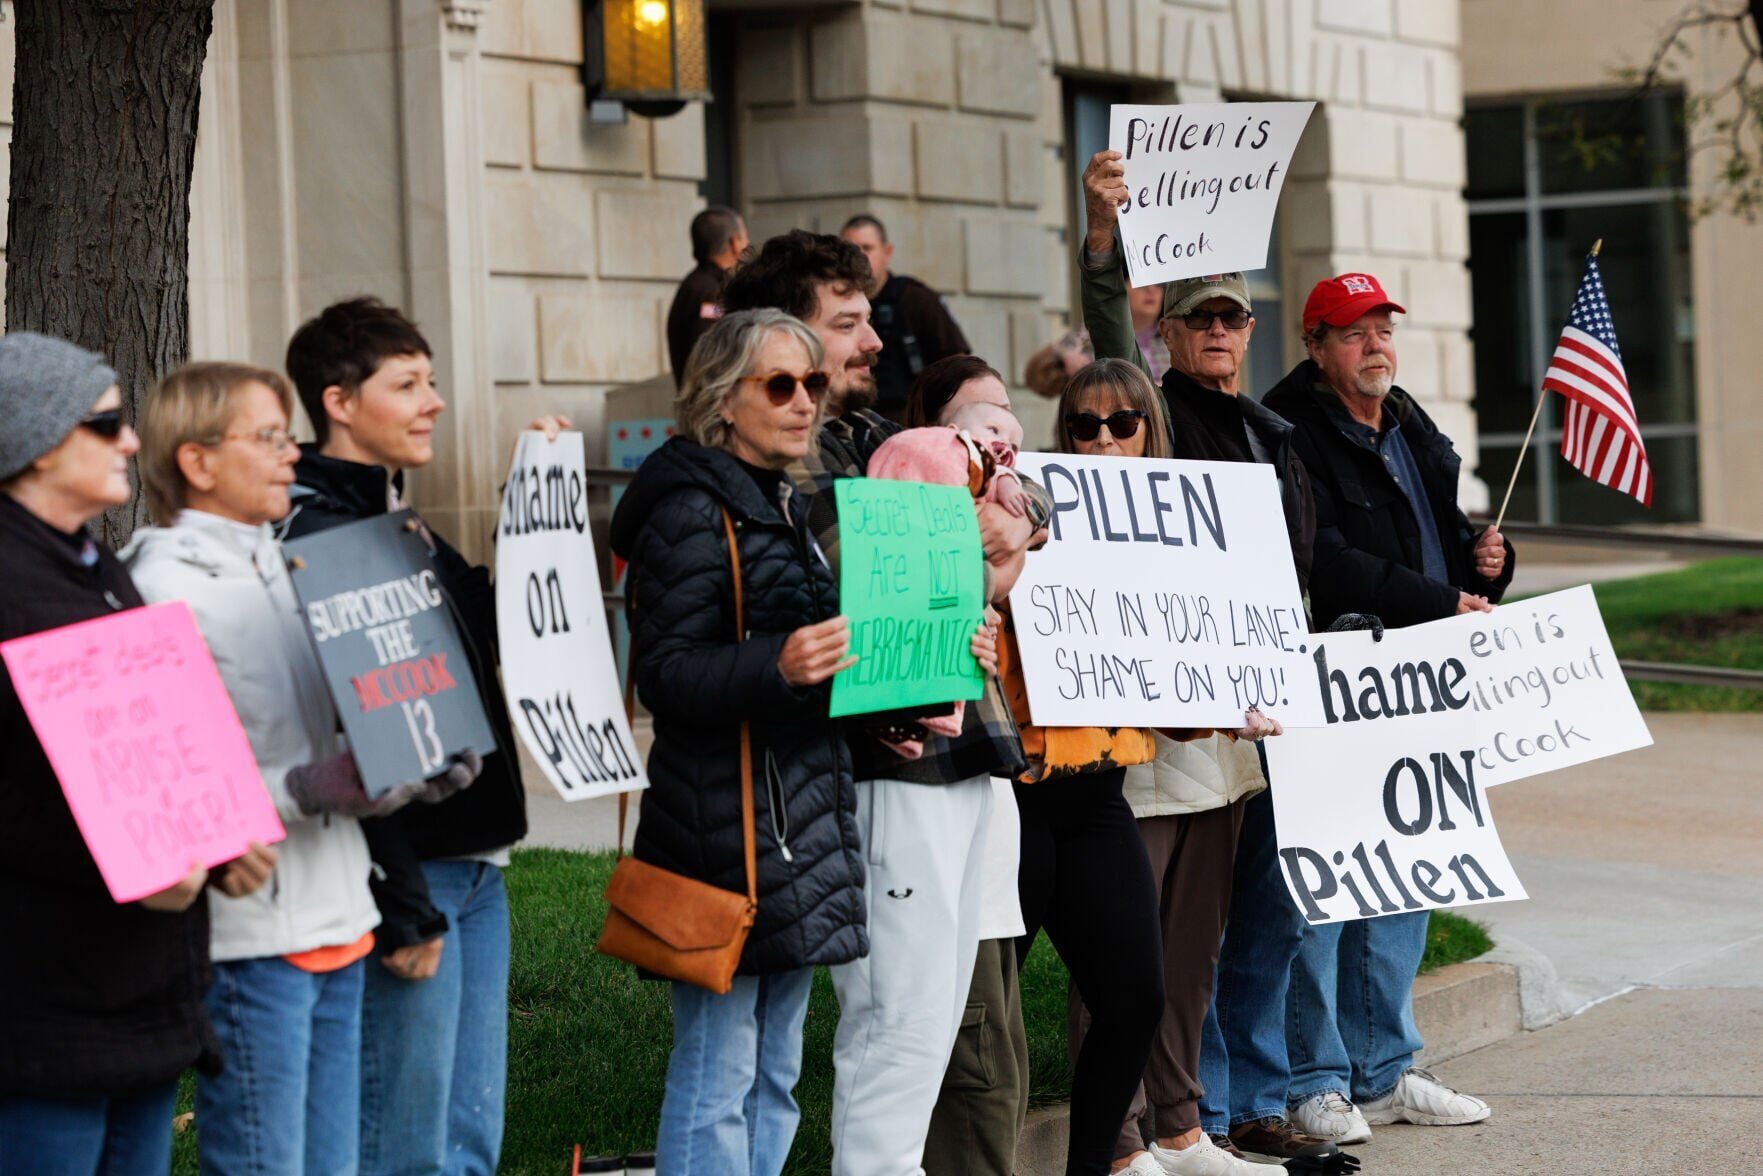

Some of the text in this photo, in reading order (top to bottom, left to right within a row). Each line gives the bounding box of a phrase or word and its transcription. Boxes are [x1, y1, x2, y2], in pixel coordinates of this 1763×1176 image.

[1126, 113, 1271, 160] Pillen is
[1229, 160, 1280, 193] out
[1126, 231, 1214, 278] McCook
[846, 481, 968, 537] Secret Deals
[1041, 462, 1227, 552] PILLEN
[527, 567, 570, 638] on
[868, 546, 960, 598] Are NOT
[307, 569, 443, 642] SUPPORTING
[1030, 584, 1308, 654] STAY IN YOUR LANE!
[1532, 612, 1565, 644] is
[365, 619, 420, 667] THE
[1553, 646, 1604, 685] out
[1056, 647, 1289, 709] SHAME ON YOU!
[1313, 643, 1471, 724] hame
[401, 698, 445, 775] 13
[519, 689, 638, 789] Pillen
[1479, 719, 1592, 770] cCook
[1382, 750, 1485, 837] ON
[1279, 839, 1506, 922] Pillen
